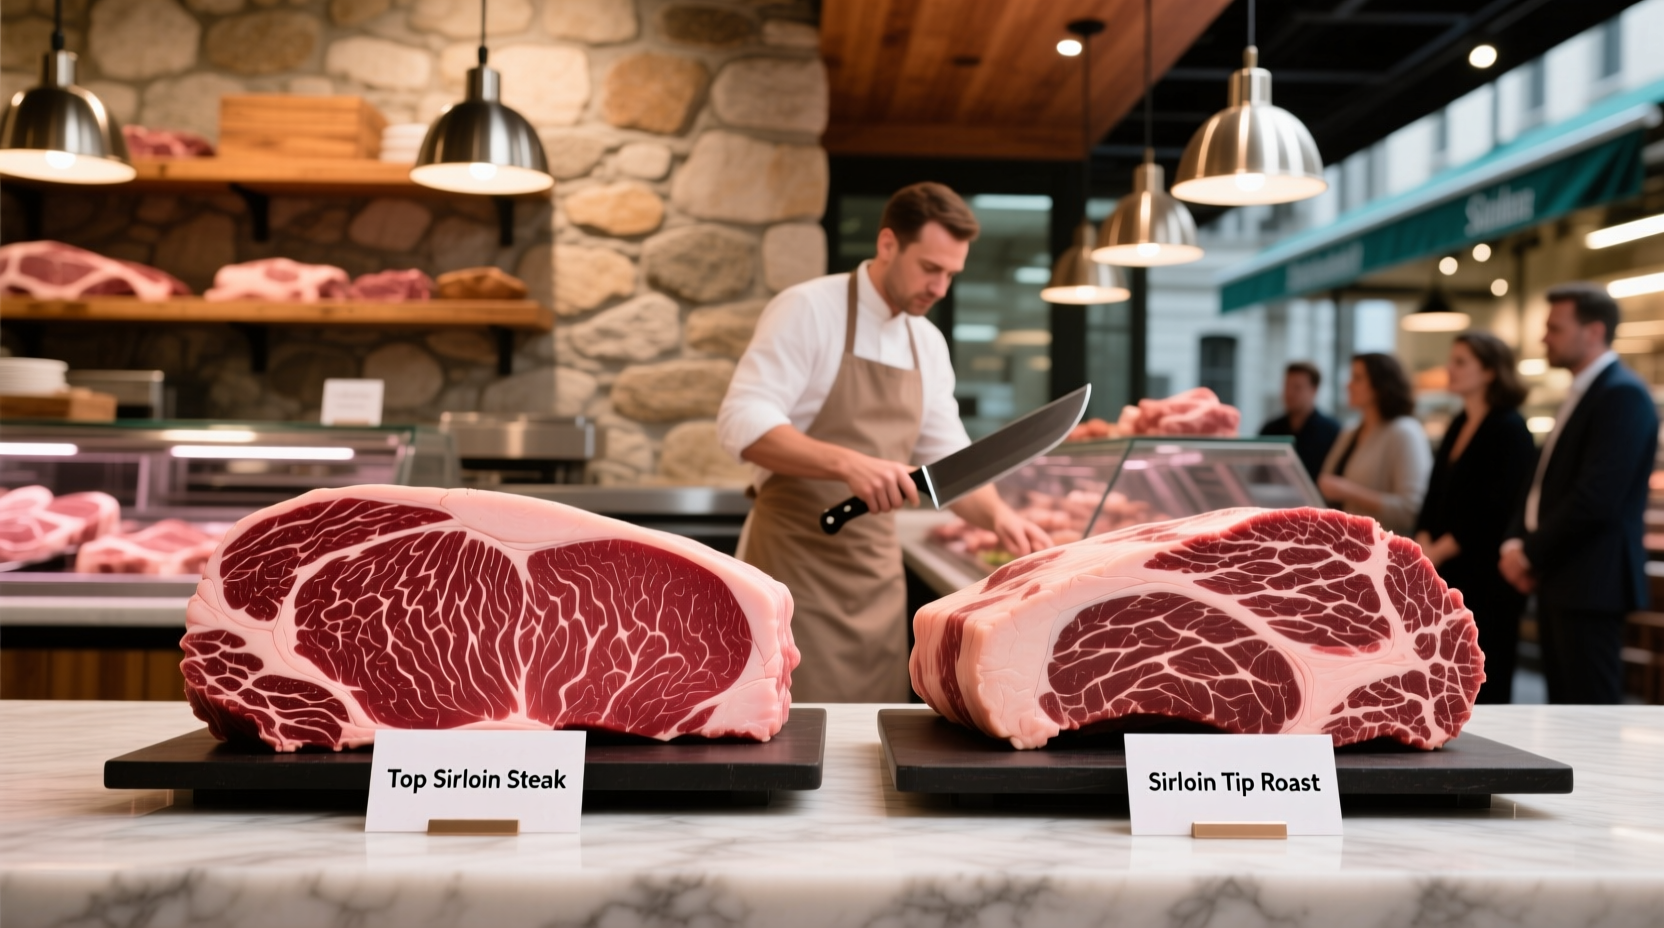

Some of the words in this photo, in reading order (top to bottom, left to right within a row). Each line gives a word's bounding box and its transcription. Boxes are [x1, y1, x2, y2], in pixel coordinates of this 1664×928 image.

[387, 768, 427, 794] Top
[433, 768, 501, 789] Sirloin
[507, 769, 567, 789] Steak
[1148, 771, 1217, 792] Sirloin
[1220, 771, 1255, 797] Tip
[1260, 772, 1321, 792] Roast
